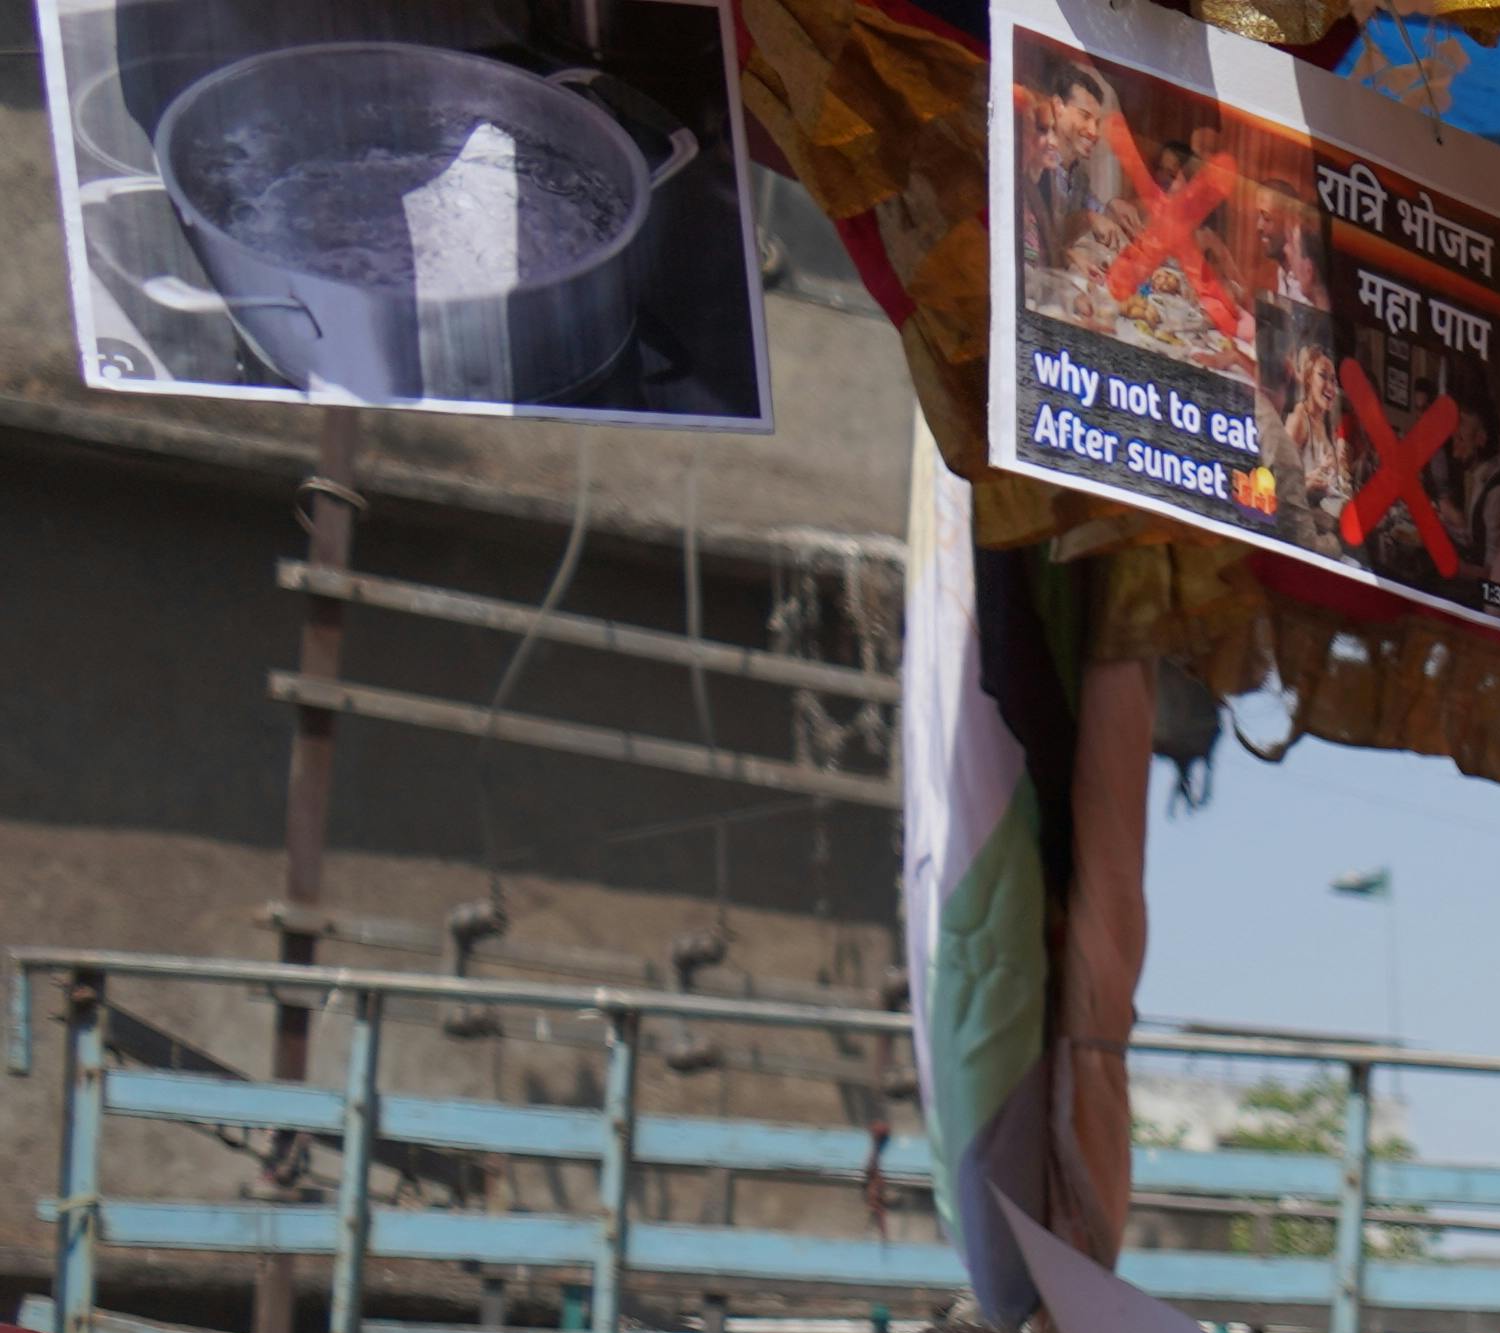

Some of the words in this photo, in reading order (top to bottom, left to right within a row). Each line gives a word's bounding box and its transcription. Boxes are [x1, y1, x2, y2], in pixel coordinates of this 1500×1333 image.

[1317, 162, 1386, 234] रात्रि
[1397, 187, 1494, 279] भोजन
[1358, 268, 1421, 337] महा
[1430, 303, 1491, 361] पाप
[1033, 349, 1099, 405] why
[1109, 372, 1162, 420] not
[1169, 391, 1201, 434] to
[1211, 406, 1259, 454] eat
[1033, 404, 1117, 465] After
[1127, 443, 1229, 500] sunset
